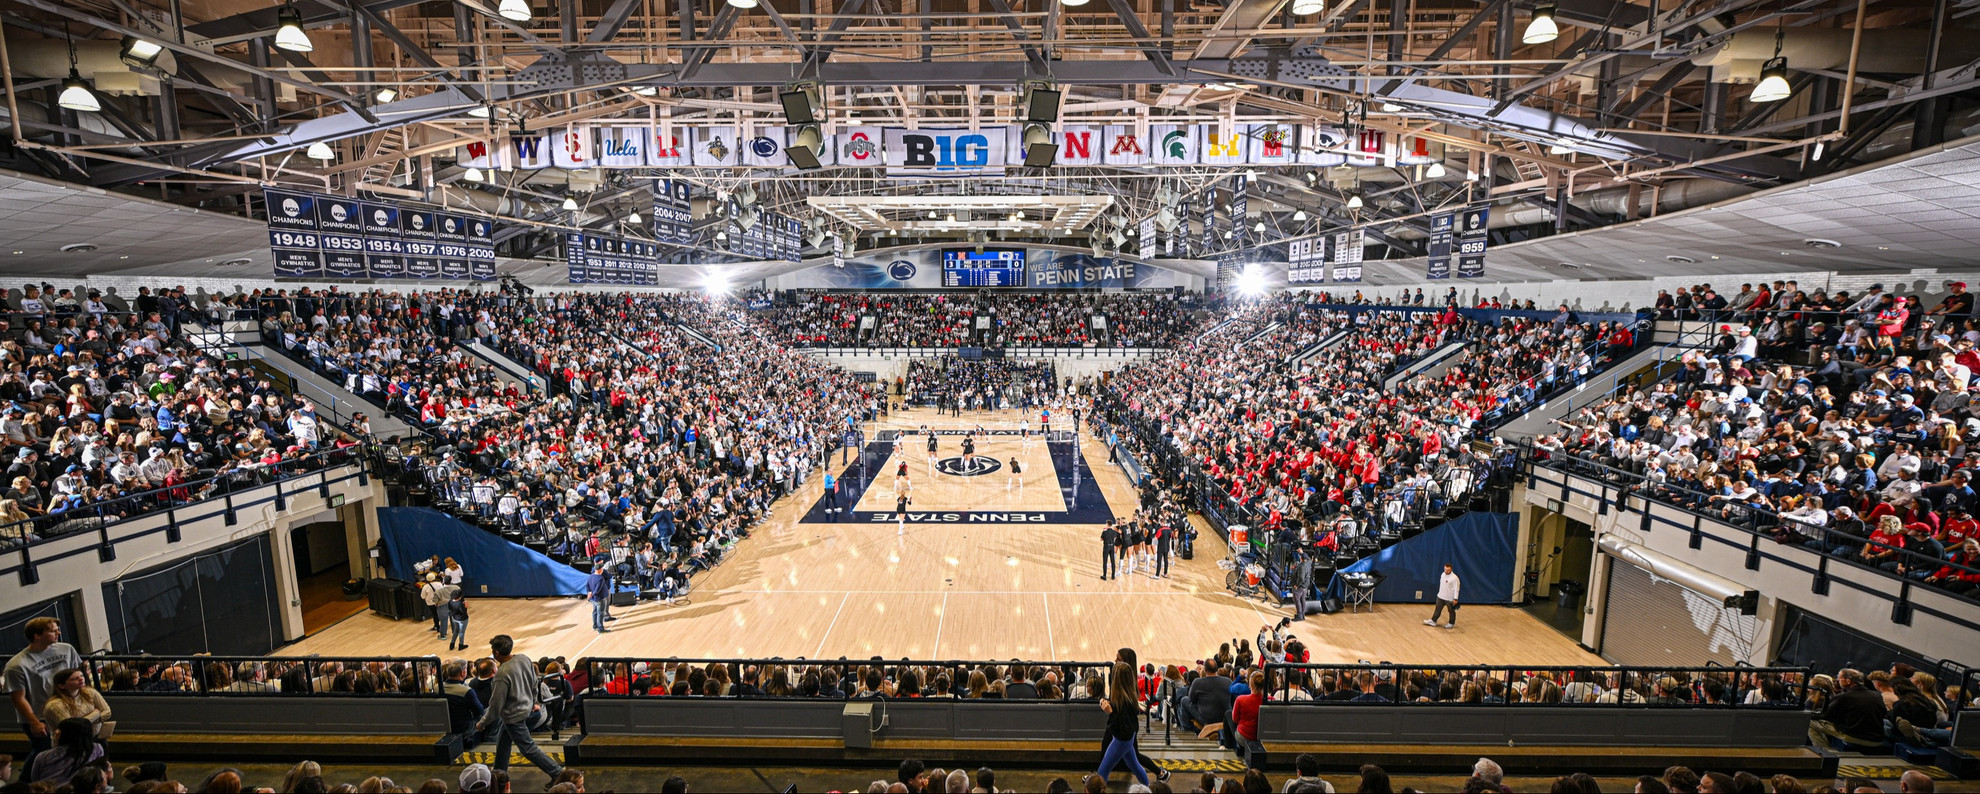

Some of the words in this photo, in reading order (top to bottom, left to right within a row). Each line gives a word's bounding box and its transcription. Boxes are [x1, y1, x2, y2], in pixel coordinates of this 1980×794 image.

[511, 136, 542, 159] W
[1064, 131, 1091, 159] N
[1110, 135, 1143, 156] M
[654, 206, 674, 219] 2004
[675, 211, 691, 223] 2007
[272, 216, 314, 226] CHAMPIONS
[322, 221, 360, 230] CHAMPIONS
[366, 225, 400, 234] CHAMPIONS
[405, 229, 434, 237] CHAMPIONS
[1463, 228, 1486, 236] CHAMPIONS
[273, 233, 316, 247] 1948
[324, 237, 362, 250] 1953
[367, 240, 401, 252] 1954
[406, 243, 435, 254] 1957
[440, 246, 466, 257] 1976
[1461, 242, 1484, 253] 1959
[469, 248, 495, 259] 2000
[1029, 264, 1044, 272] WE
[1046, 262, 1064, 271] ARE
[1035, 268, 1080, 286] PENN
[1084, 263, 1135, 282] STATE
[969, 513, 1046, 522] PENN
